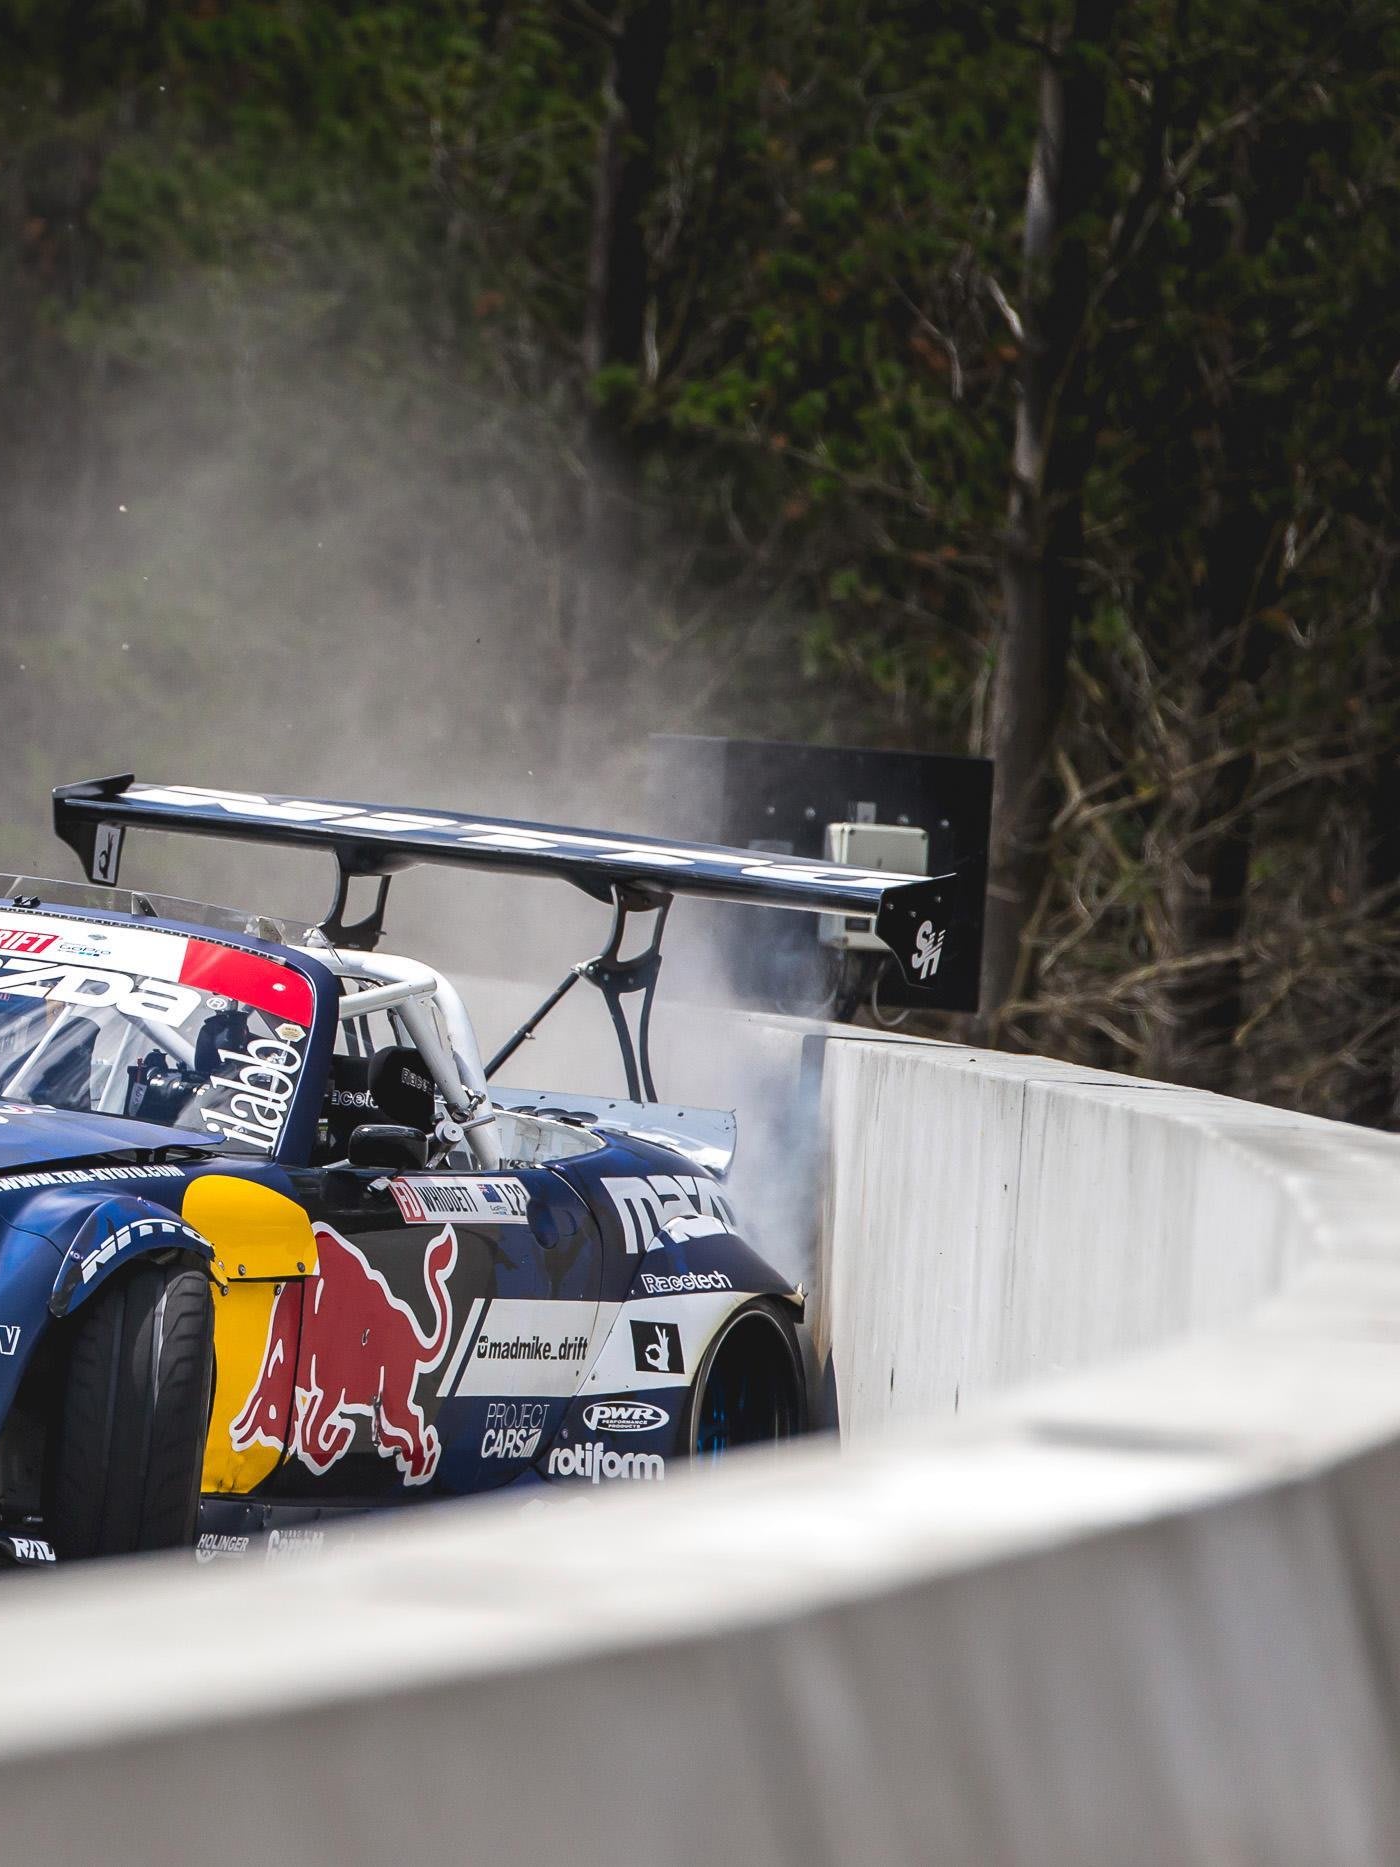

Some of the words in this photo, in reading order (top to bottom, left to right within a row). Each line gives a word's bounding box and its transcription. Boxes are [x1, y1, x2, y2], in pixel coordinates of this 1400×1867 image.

[414, 1186, 478, 1213] WHIDDETT
[640, 1270, 733, 1294] Racetech
[488, 1335, 589, 1361] madmike_drift
[485, 1403, 550, 1429] PROJECT
[481, 1429, 526, 1458] CARS
[548, 1442, 665, 1484] rotiform
[197, 1533, 250, 1551] HOLINGER
